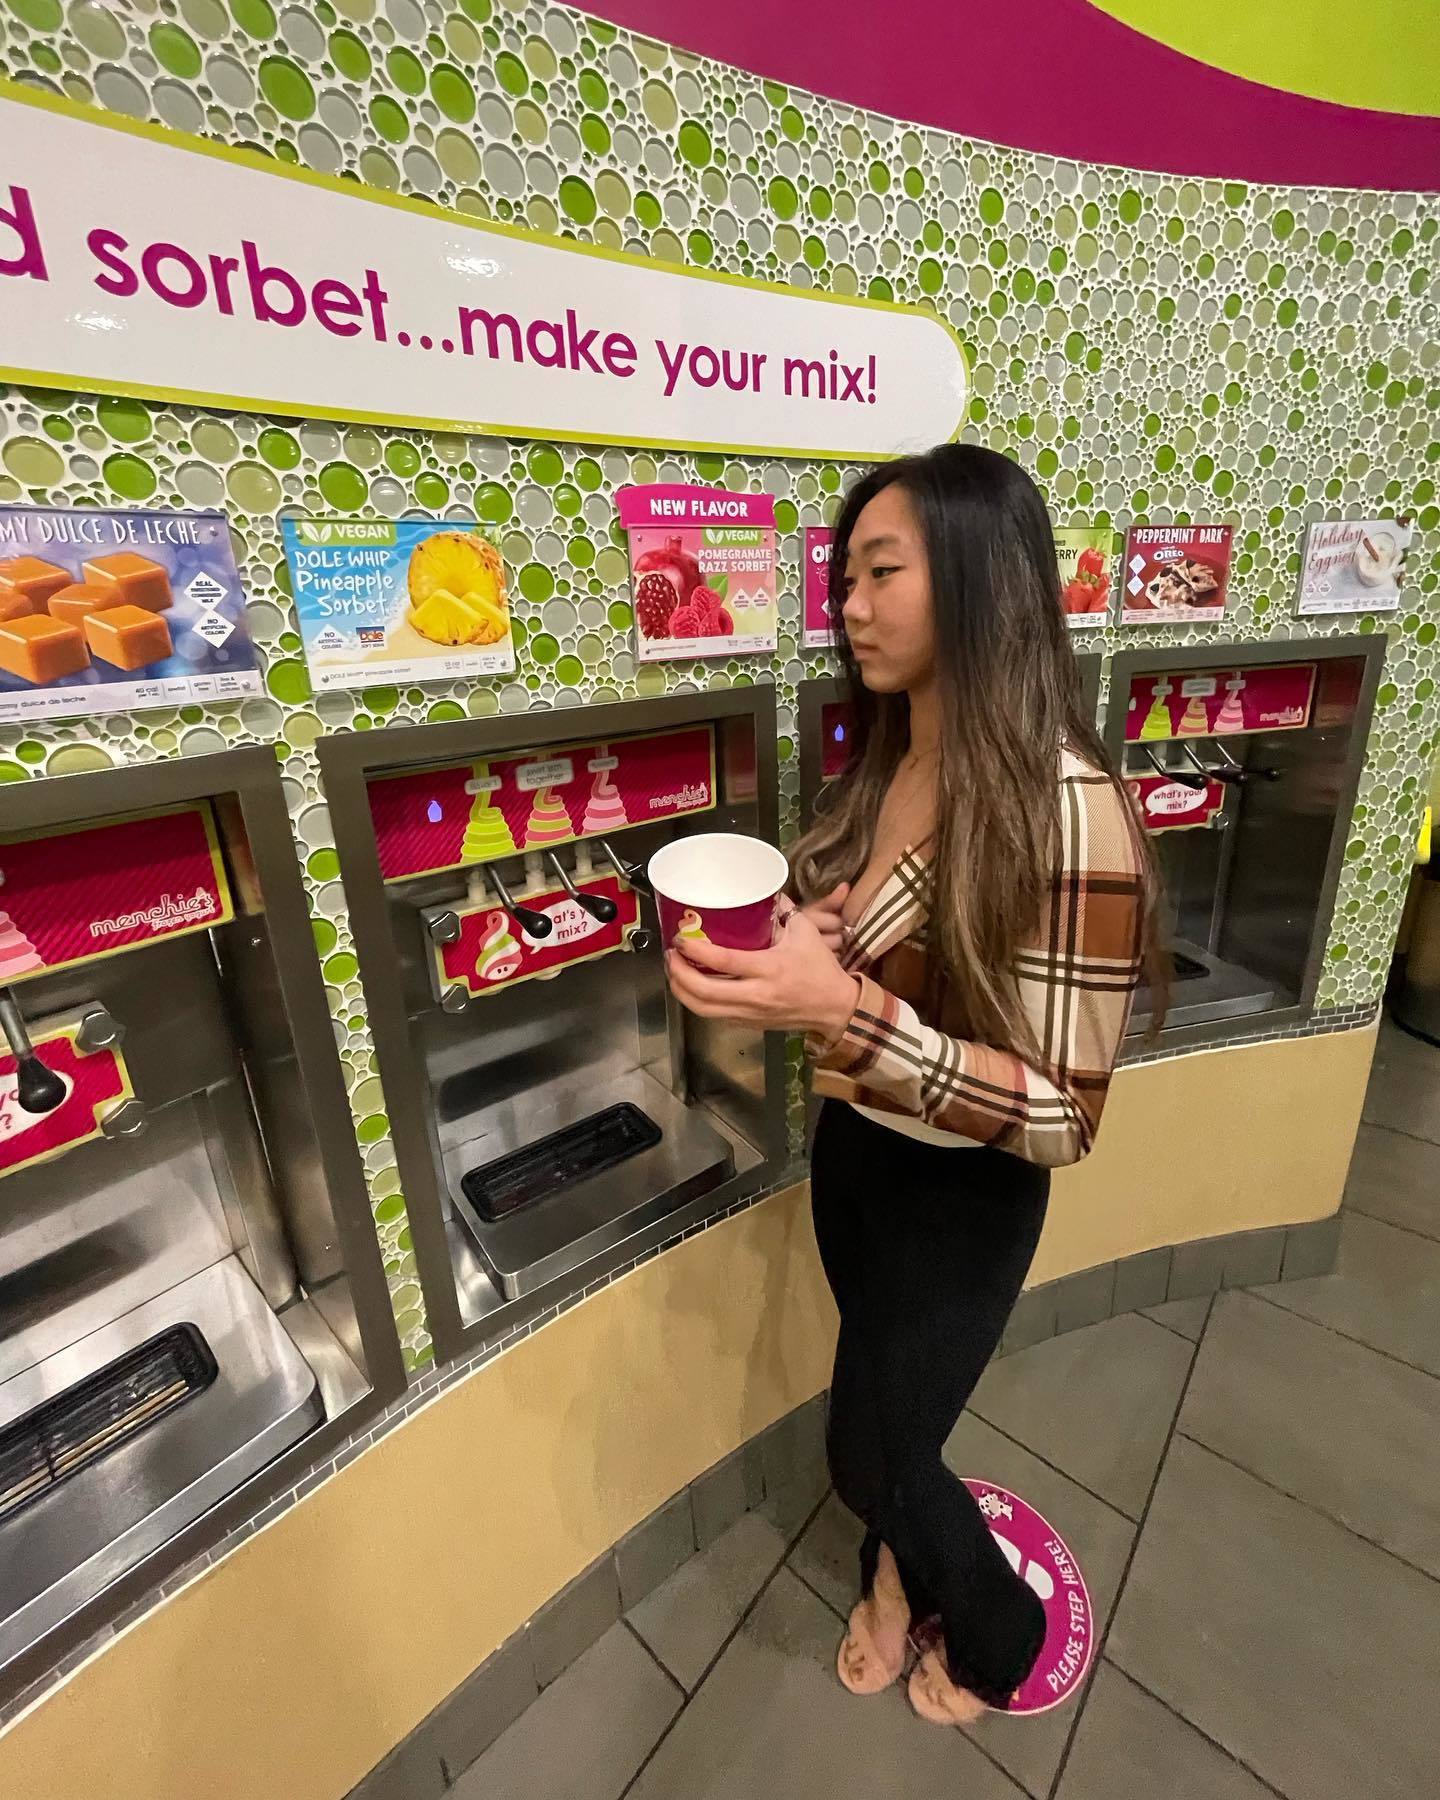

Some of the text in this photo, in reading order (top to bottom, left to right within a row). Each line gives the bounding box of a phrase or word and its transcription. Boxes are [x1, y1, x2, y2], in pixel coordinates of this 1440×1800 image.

[655, 339, 767, 397] your
[784, 349, 876, 404] mix!
[650, 499, 748, 518] NEW FLAVOR
[37, 517, 105, 545] DULCE
[112, 519, 137, 545] DE
[146, 520, 202, 545] LECHE
[333, 523, 390, 539] VEGAN
[724, 529, 758, 542] VEGAN
[1136, 528, 1196, 544] PEPPERMINT
[1311, 523, 1364, 550] Holiday
[295, 550, 391, 569] DOLE WHIP
[698, 548, 772, 561] POMEGRANATE
[1054, 548, 1078, 560] ERRY
[1153, 550, 1184, 561] OREO
[698, 560, 772, 574] RAZZ SORBET
[296, 569, 395, 595] Pineapple
[319, 592, 388, 617] Sorbet
[360, 630, 384, 641] Dole
[1154, 789, 1181, 799] what's
[1167, 800, 1188, 810] mix?
[90, 887, 214, 938] menchie's
[151, 906, 216, 931] frozen yogurt
[553, 909, 576, 924] at's
[557, 921, 588, 940] mix?
[1044, 1539, 1085, 1694] PLEASE STEP HERE!
